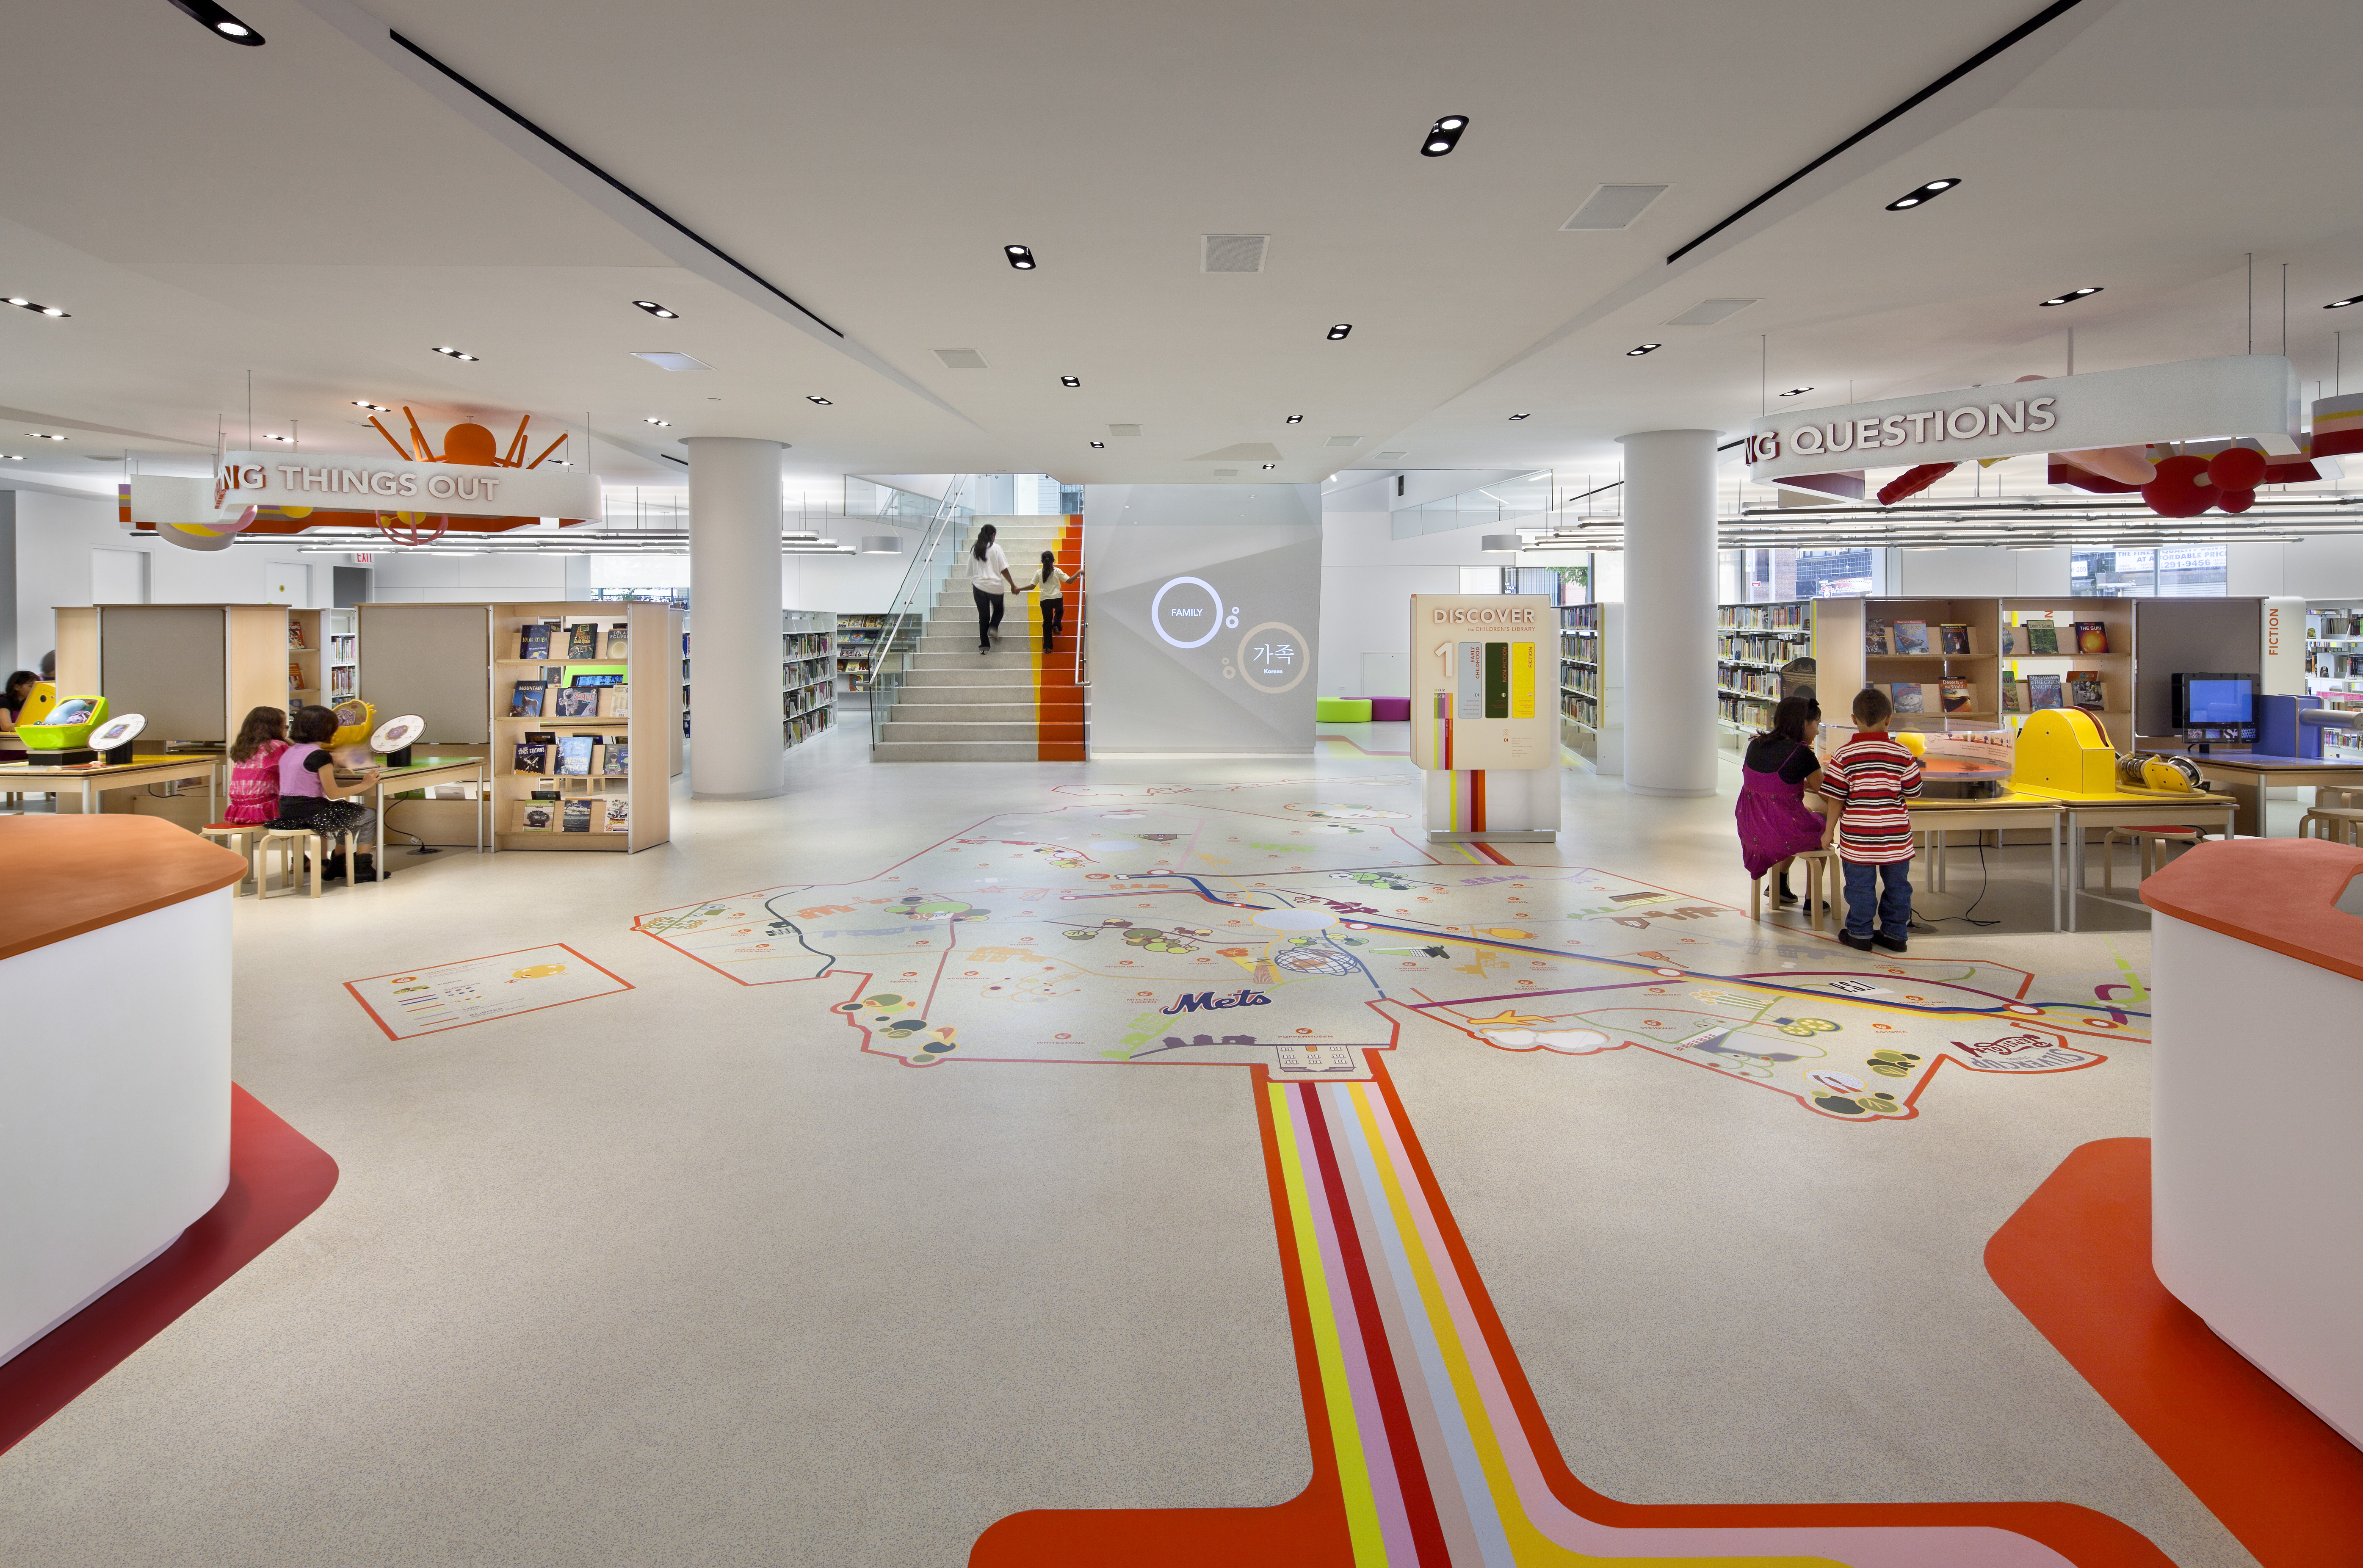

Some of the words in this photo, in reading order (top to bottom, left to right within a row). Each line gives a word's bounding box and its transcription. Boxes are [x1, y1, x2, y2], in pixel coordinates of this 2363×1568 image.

[1790, 397, 2056, 455] QUESTIONS
[278, 465, 418, 497] THINGS
[428, 475, 500, 501] OUT
[2149, 553, 2201, 562] AFORDABLE
[2164, 559, 2211, 568] 291-9456
[1171, 608, 1203, 617] FAMILY
[1434, 609, 1535, 623] DISCOVER
[2269, 608, 2278, 655] FICTION
[1253, 643, 1295, 666] 가족
[1434, 642, 1453, 677] 1
[574, 692, 594, 701] SPACE
[1161, 989, 1273, 1015] Mets
[1969, 1048, 2087, 1070] SILVERCUP
